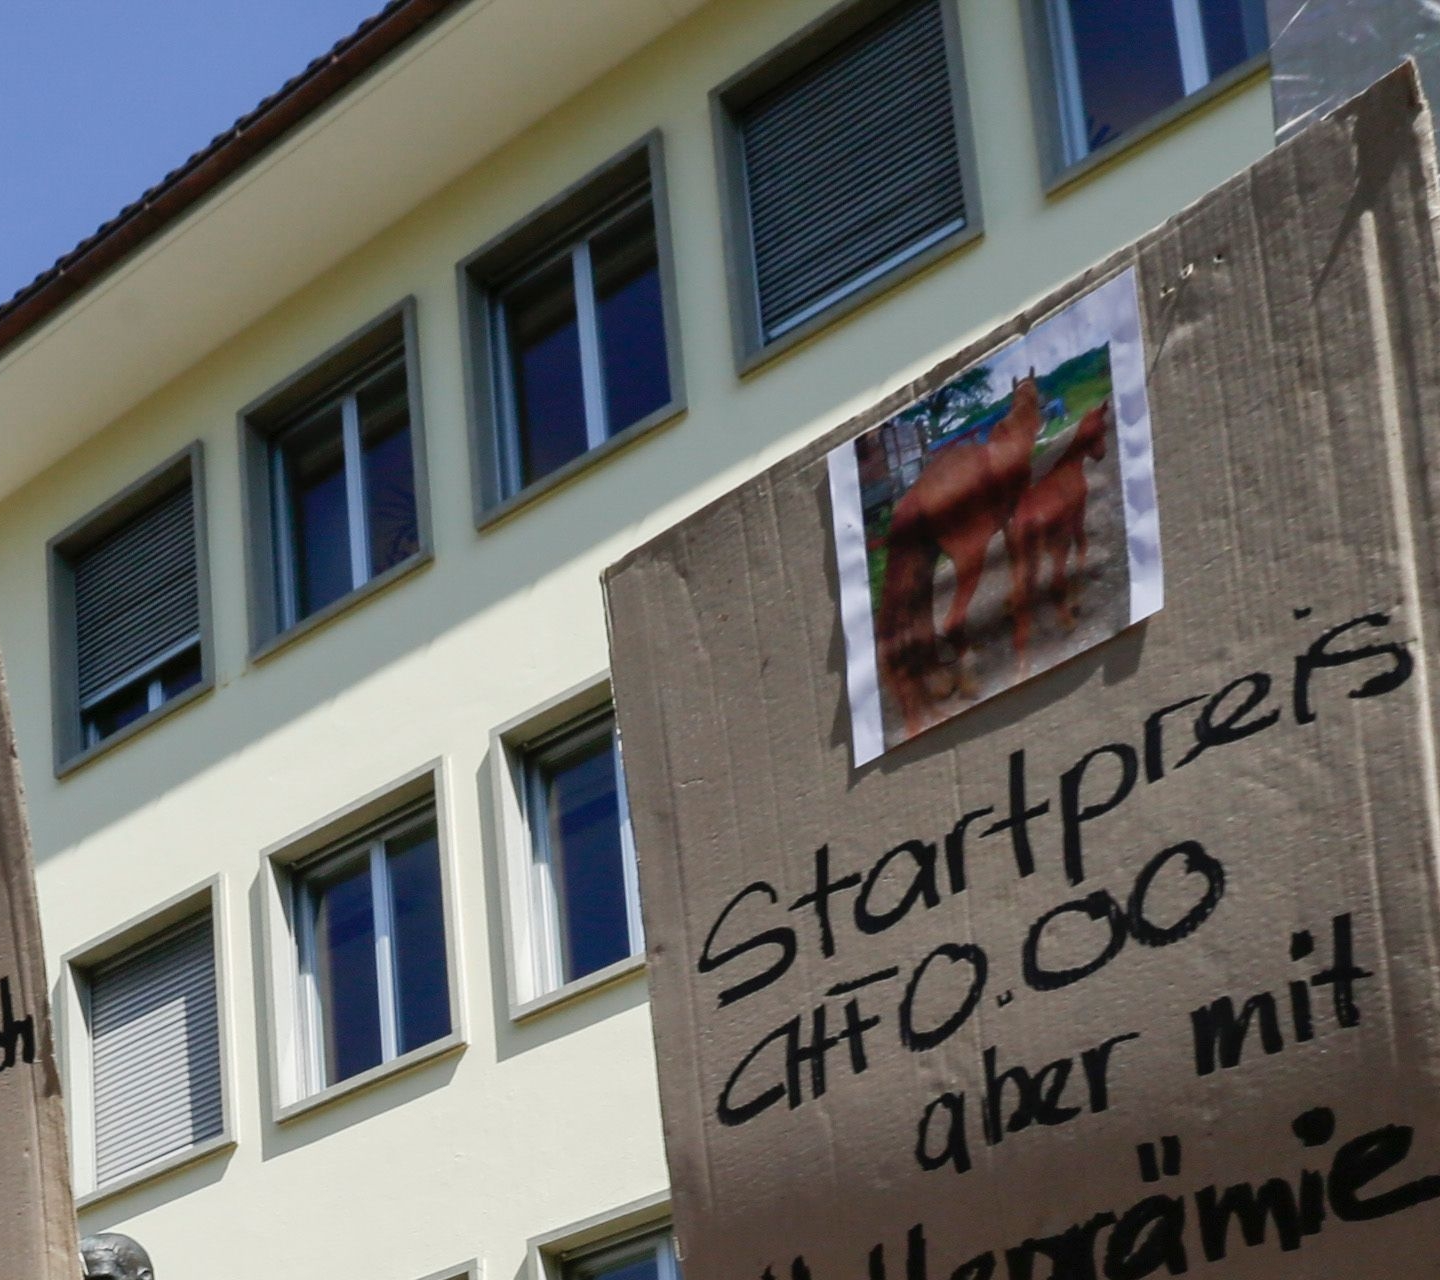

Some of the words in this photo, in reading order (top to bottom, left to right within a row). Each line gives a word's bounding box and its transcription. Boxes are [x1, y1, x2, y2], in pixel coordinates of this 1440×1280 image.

[697, 606, 1414, 1008] Startpreis
[915, 1033, 1140, 1173] aber
[1188, 914, 1374, 1075] mit
